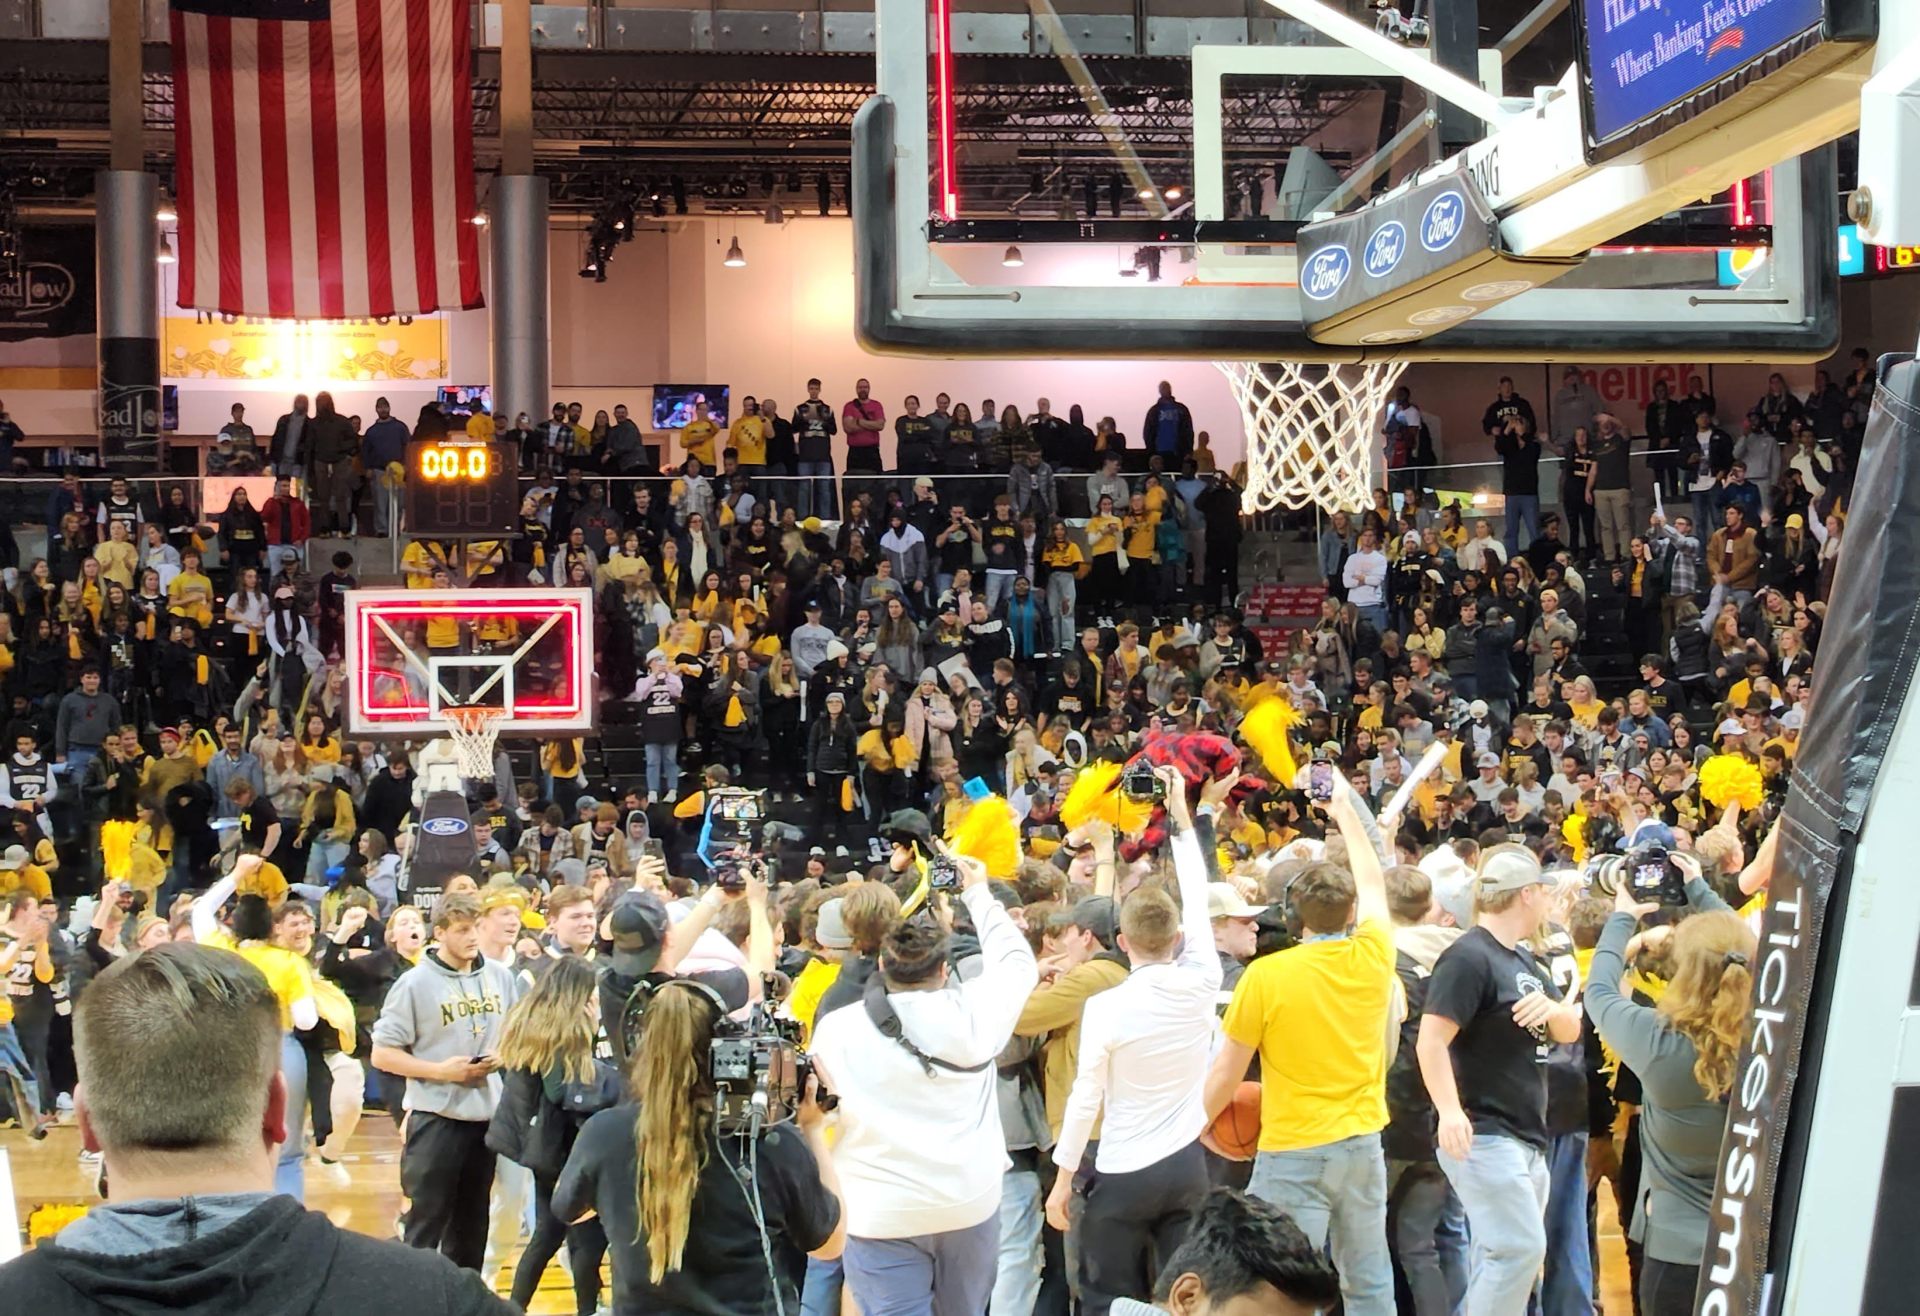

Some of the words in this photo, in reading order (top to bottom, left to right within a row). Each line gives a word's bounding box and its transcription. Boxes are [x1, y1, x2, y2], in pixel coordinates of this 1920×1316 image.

[1611, 49, 1654, 88] Where
[1652, 19, 1705, 68] Banking
[1702, 1, 1737, 39] Feels
[1427, 200, 1458, 250] Ford
[1369, 228, 1400, 270] Ford
[1311, 252, 1344, 293] Ford
[1496, 406, 1519, 419] NKU
[421, 449, 486, 480] 00.0
[652, 691, 671, 706] 22
[21, 783, 41, 799] 22
[430, 819, 460, 832] Ford
